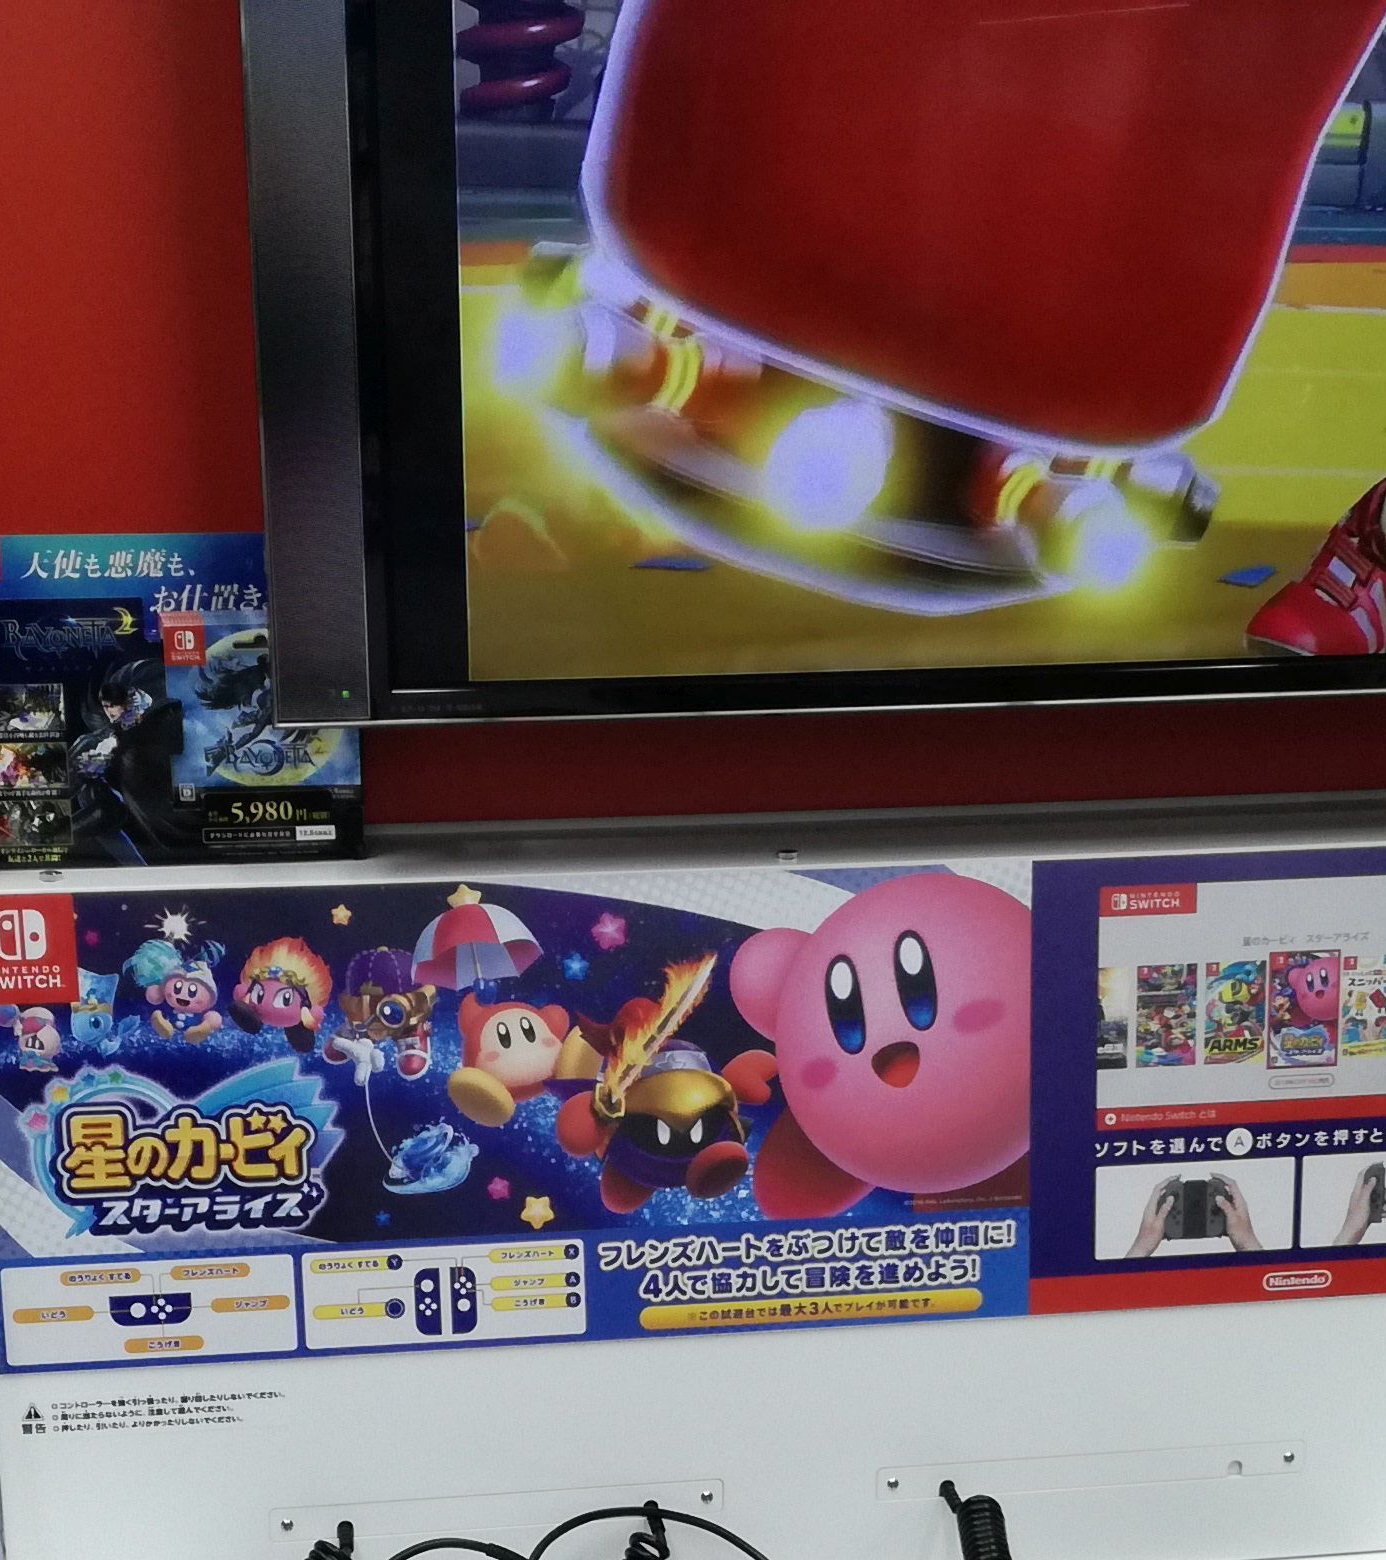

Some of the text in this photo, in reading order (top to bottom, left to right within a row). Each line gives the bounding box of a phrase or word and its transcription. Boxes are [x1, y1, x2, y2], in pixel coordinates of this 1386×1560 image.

[21, 549, 195, 580] 天使も悪魔も、
[1130, 898, 1181, 910] SWITCH
[1210, 1037, 1258, 1052] ARMS
[1164, 1109, 1196, 1120] Switch
[67, 1111, 311, 1191] 星のカービィ
[1095, 1137, 1223, 1157] ソフトを選んで
[99, 1192, 305, 1226] スターアライズ
[1269, 1274, 1327, 1287] Nintendo
